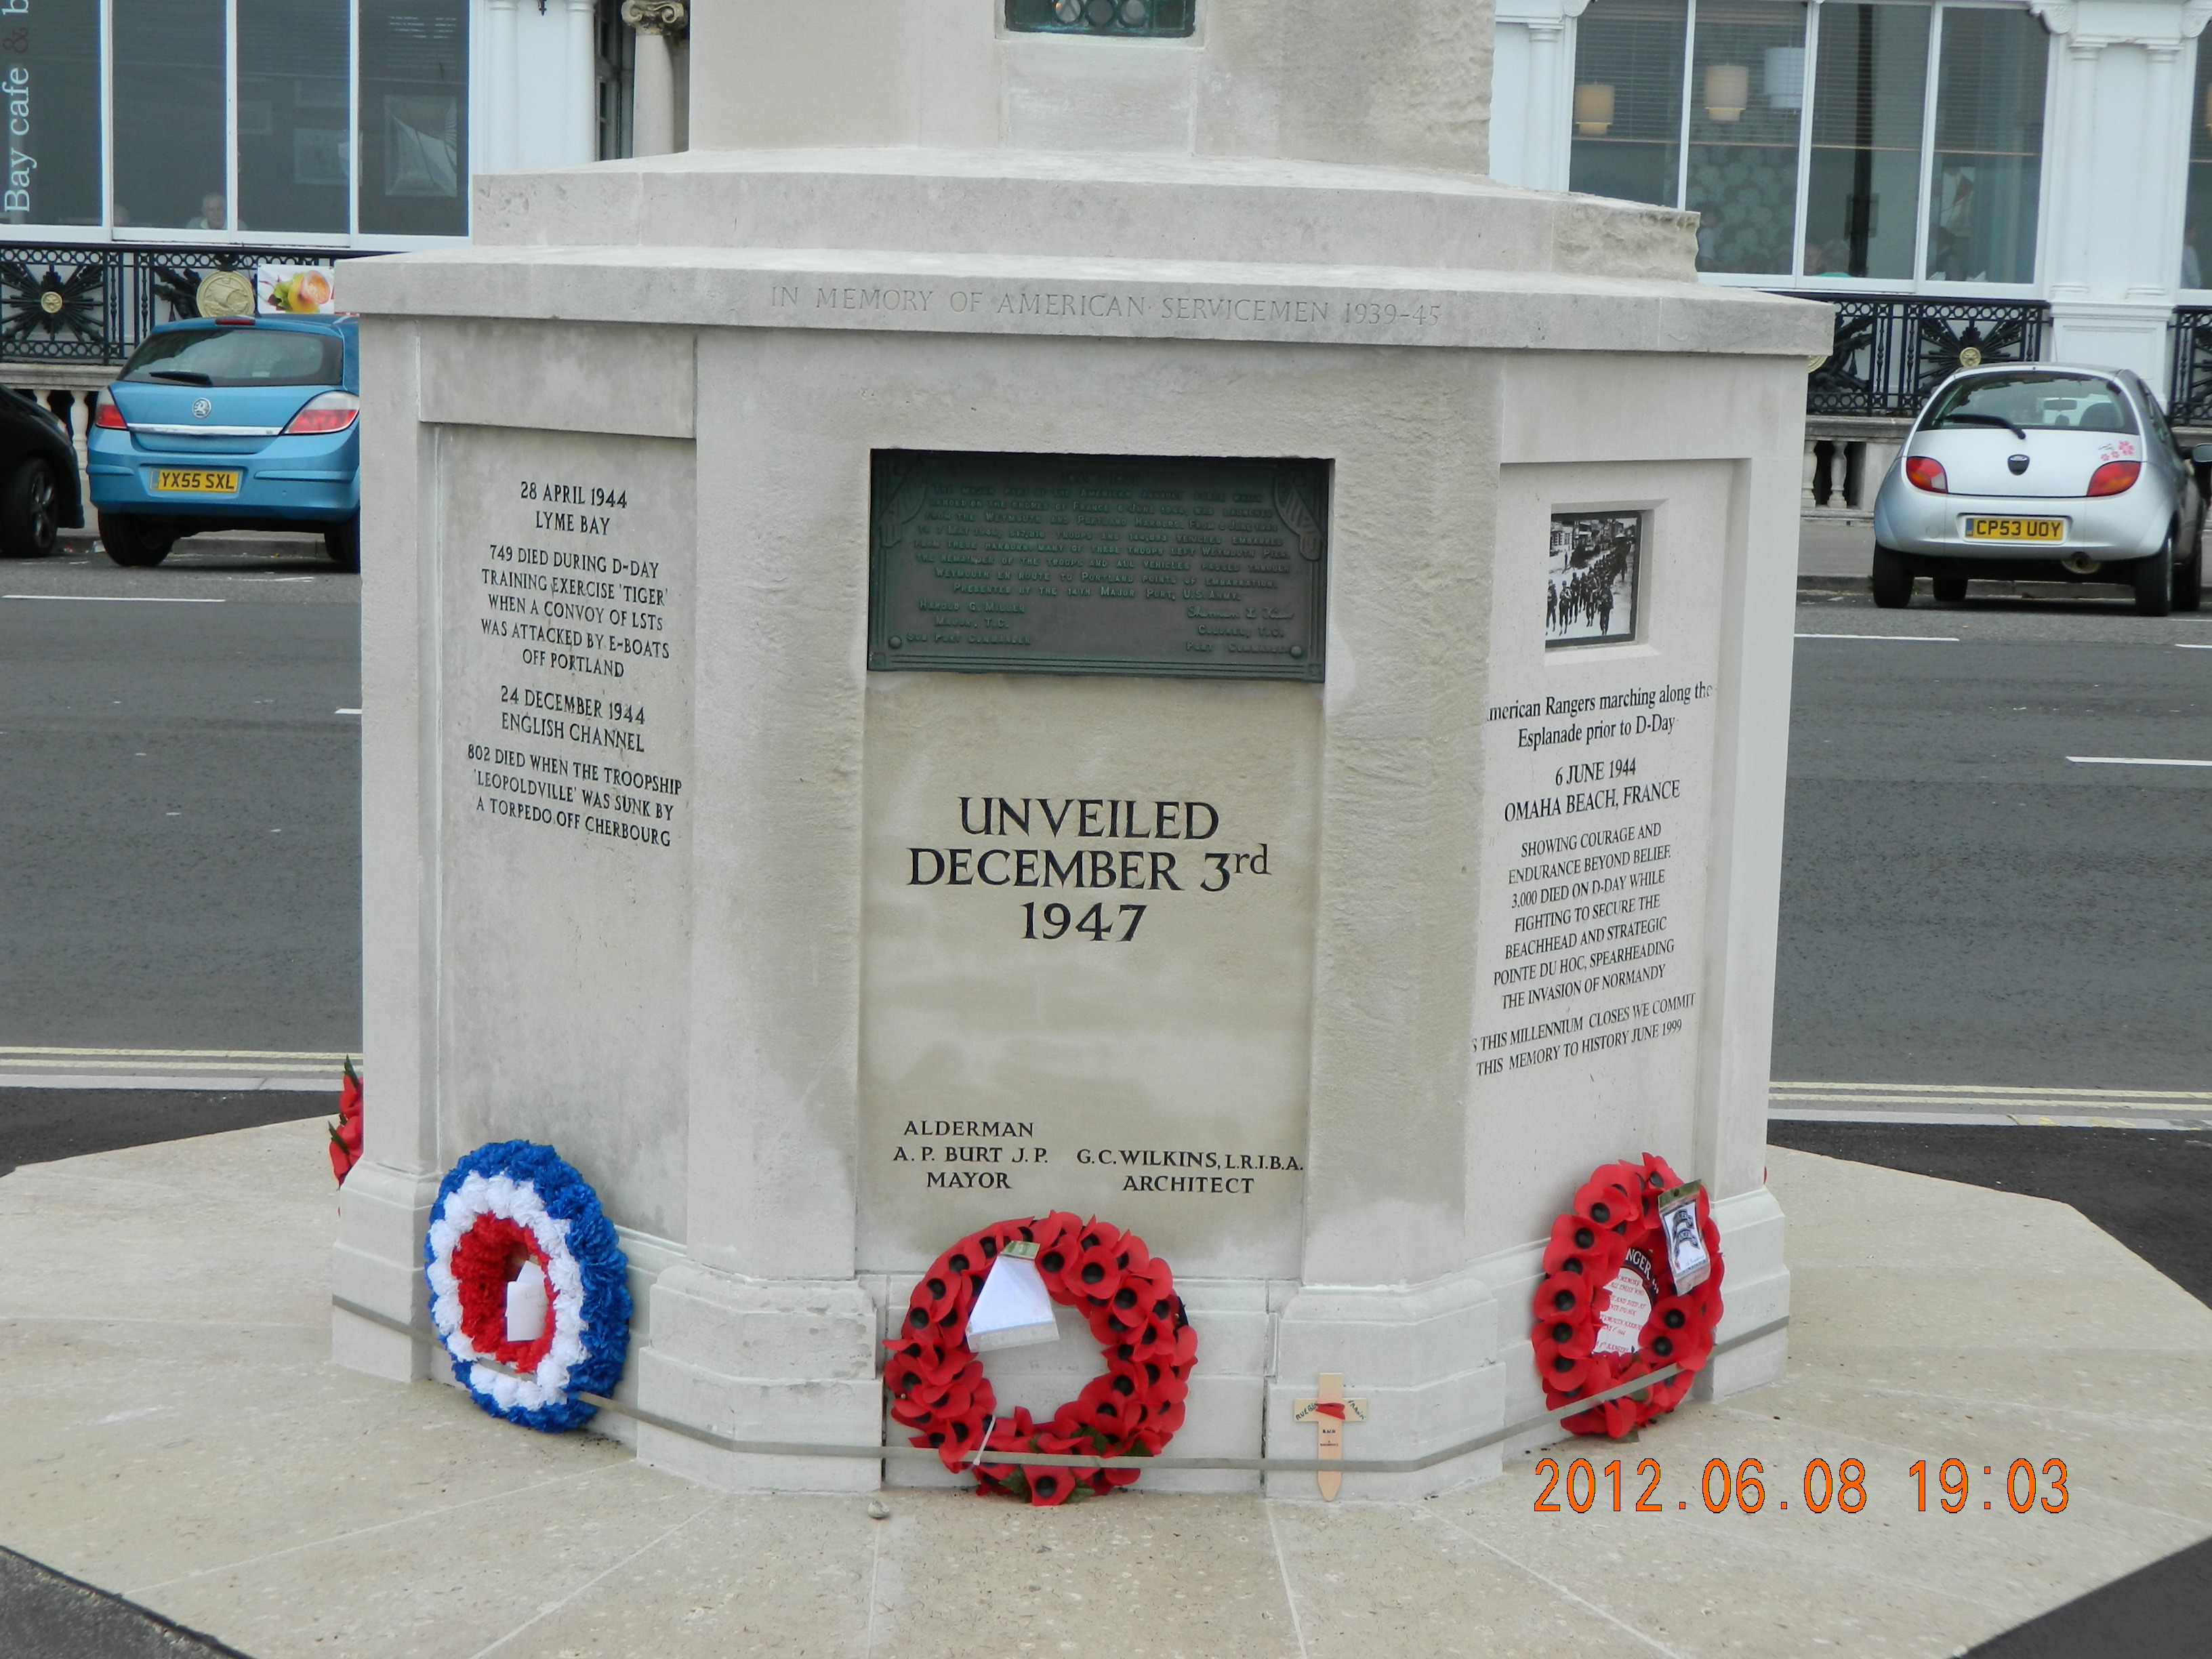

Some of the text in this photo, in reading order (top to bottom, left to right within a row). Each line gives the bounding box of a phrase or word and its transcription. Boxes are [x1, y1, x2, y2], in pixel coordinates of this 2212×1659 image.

[2, 68, 29, 136] cafe
[4, 147, 37, 212] Bay
[771, 287, 1441, 326] IN MEMORY OF AMERICAN SERVICEMEN 1939-45
[162, 472, 234, 489] YX55 SXL
[520, 480, 628, 509] 28 APRIL 1944
[535, 510, 611, 536] LYME BAY
[1977, 520, 2060, 537] CP53 UOY
[489, 544, 659, 579] 749 DIED DURING D-DAY
[481, 568, 548, 592] TRAINING
[550, 576, 615, 600] EXERCISE
[487, 593, 526, 615] WHEN
[529, 598, 539, 615] A
[544, 600, 605, 624] CONVOY
[609, 609, 628, 627] OF
[480, 618, 670, 659] WAS ATTACKED BY E-BOATS
[522, 648, 625, 678] OFF PORTLAND
[501, 684, 646, 725] 24 DECEMBER 1944
[1486, 699, 1541, 722] merican
[1544, 696, 1596, 718] Rangers
[1599, 687, 1656, 710] marching
[1658, 684, 1692, 705] along
[501, 711, 645, 753] ENGLISH CHANNEL
[1517, 713, 1676, 752] Esplanade prior to D-Day
[467, 743, 682, 796] 802 DIED WHEN THE TROOPSHIP
[1555, 756, 1637, 787] 6 JUNE 1944
[581, 789, 611, 810] WAS
[614, 794, 651, 818] SUNK
[655, 802, 674, 821] BY
[957, 796, 1219, 840] UNVEILED
[1504, 779, 1681, 823] OMAHA BEACH, FRANCE
[476, 796, 671, 849] A TORPEDO OFF CHERBOURG
[1521, 822, 1662, 858] SHOWING COURAGE AND
[905, 842, 1273, 893] DECEMBER 3rd
[1508, 844, 1671, 885] ENDURANCE BEYOND BELIEF.
[1540, 884, 1570, 904] DIED
[1572, 881, 1589, 900] ON
[1591, 875, 1627, 895] D-DAY
[1629, 869, 1666, 888] WHILE
[1020, 901, 1148, 943] 1947
[1514, 893, 1661, 933] FIGHTING TO SECURE THE
[1504, 916, 1667, 960] BEACHHEAD AND STRATEGIC
[1493, 938, 1675, 986] POINTE DU HOC, SPEARHEADING
[1501, 963, 1666, 1010] THE INVASION OF NORMANDY
[1479, 1031, 1508, 1051] THIS
[1509, 1016, 1584, 1046] MILLENNIUM
[1589, 1006, 1630, 1029] CLOSES
[1632, 1002, 1650, 1019] WE
[1652, 993, 1696, 1015] COMMIT
[1476, 1019, 1682, 1077] THIS MEMORY TO HISTORY JUNE 1999
[903, 1120, 1034, 1139] ALDERMAN
[943, 1146, 1003, 1163] BURT
[926, 1171, 1013, 1189] MAYOR
[1122, 1175, 1255, 1194] ARCHITECT
[1625, 1248, 1652, 1280] NGER
